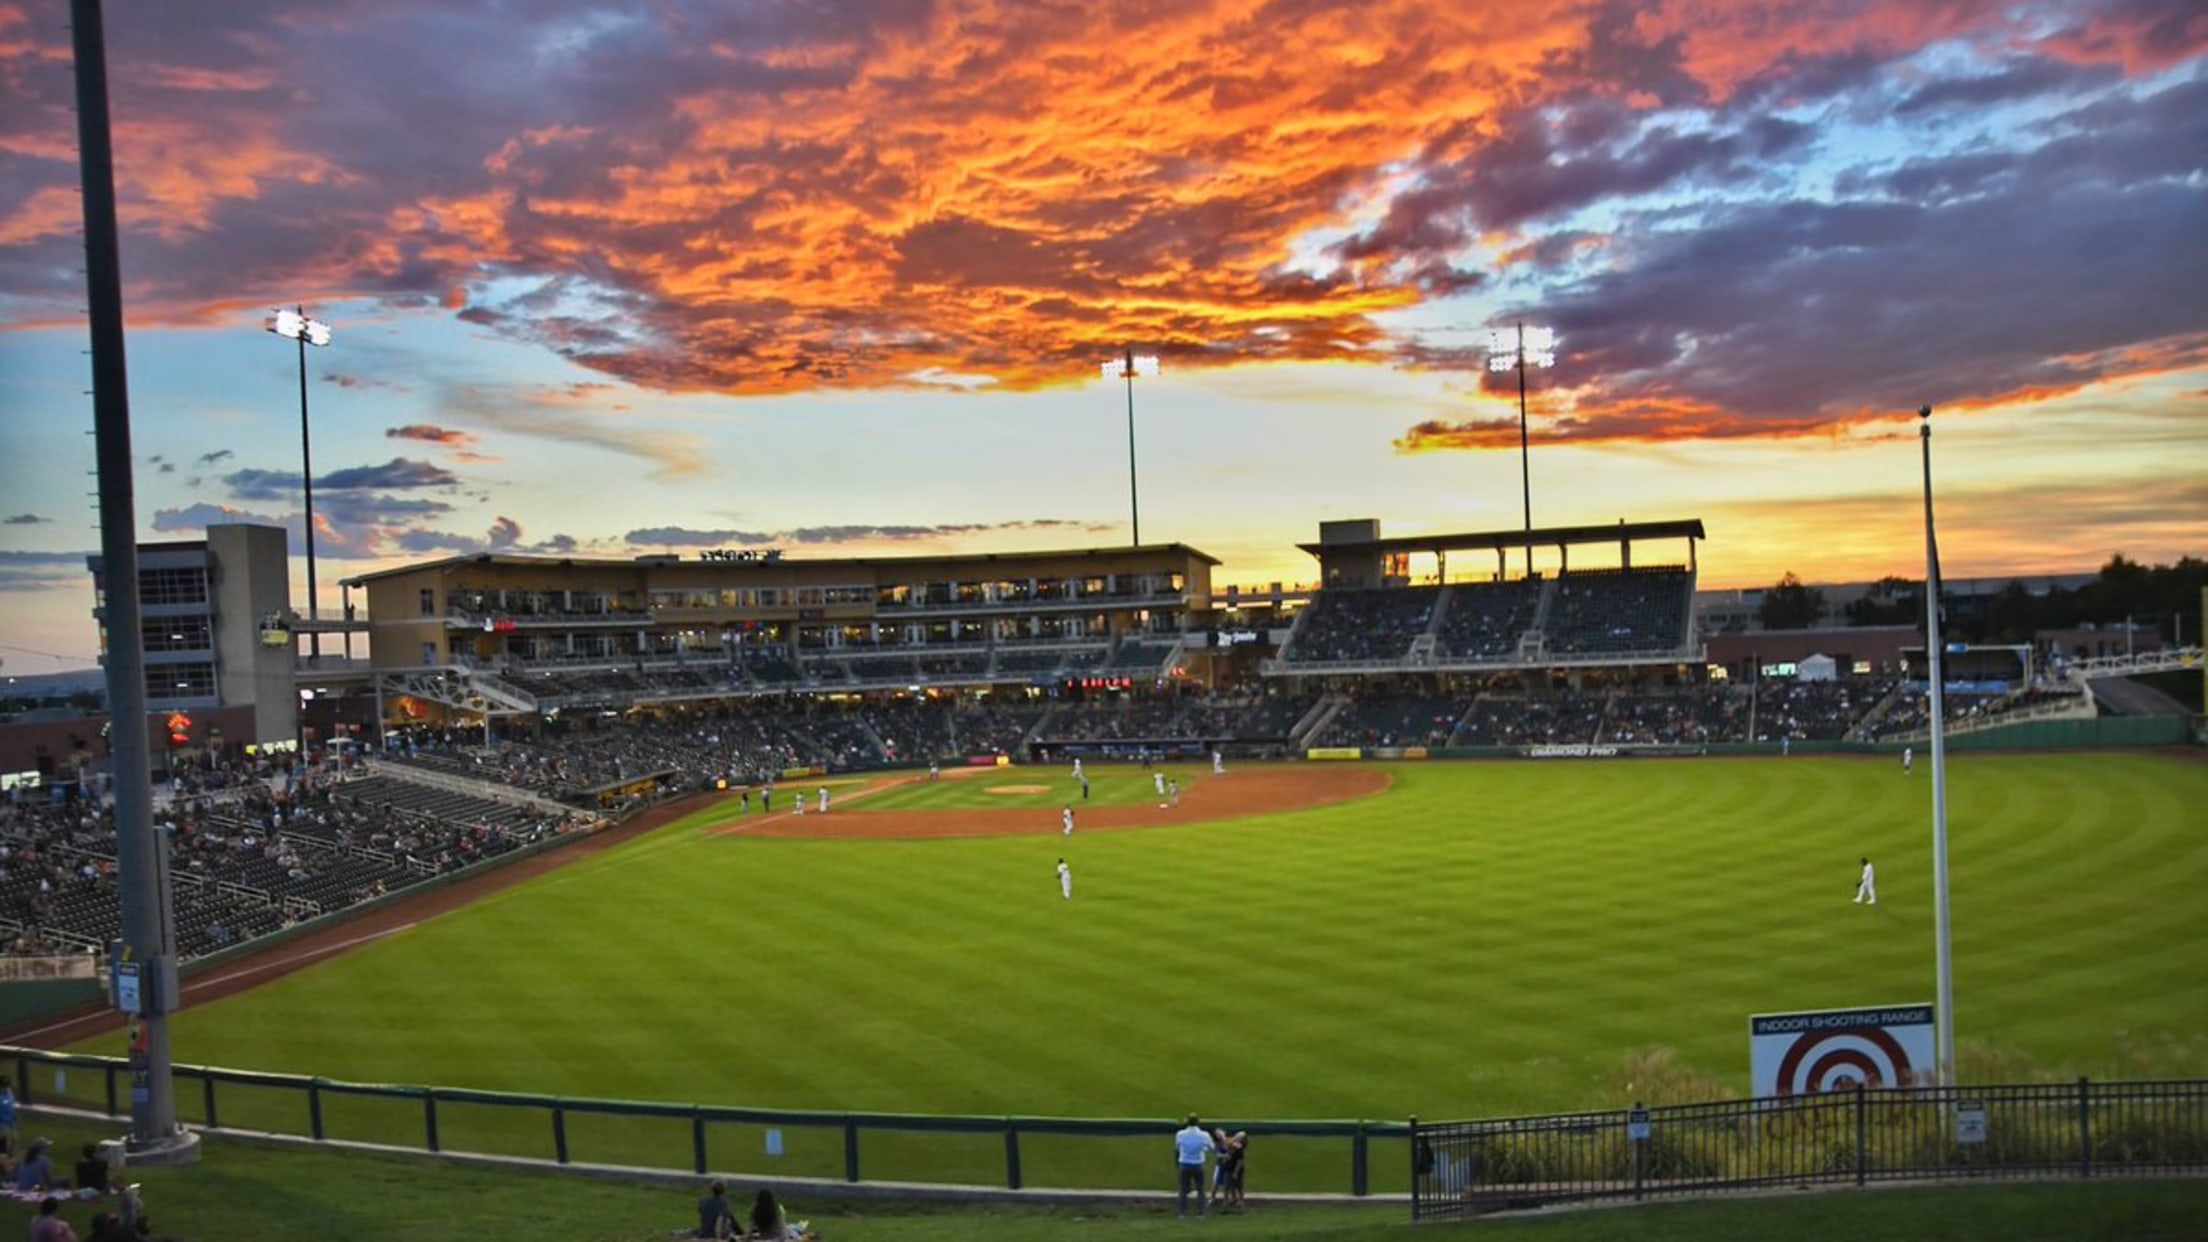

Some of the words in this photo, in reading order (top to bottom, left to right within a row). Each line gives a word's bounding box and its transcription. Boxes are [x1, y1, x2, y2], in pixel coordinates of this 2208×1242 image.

[1590, 748, 1618, 757] PRO
[1758, 1017, 1809, 1032] INDOOR
[1812, 1014, 1878, 1029] SHOOTING
[1881, 1010, 1928, 1025] RANGE
